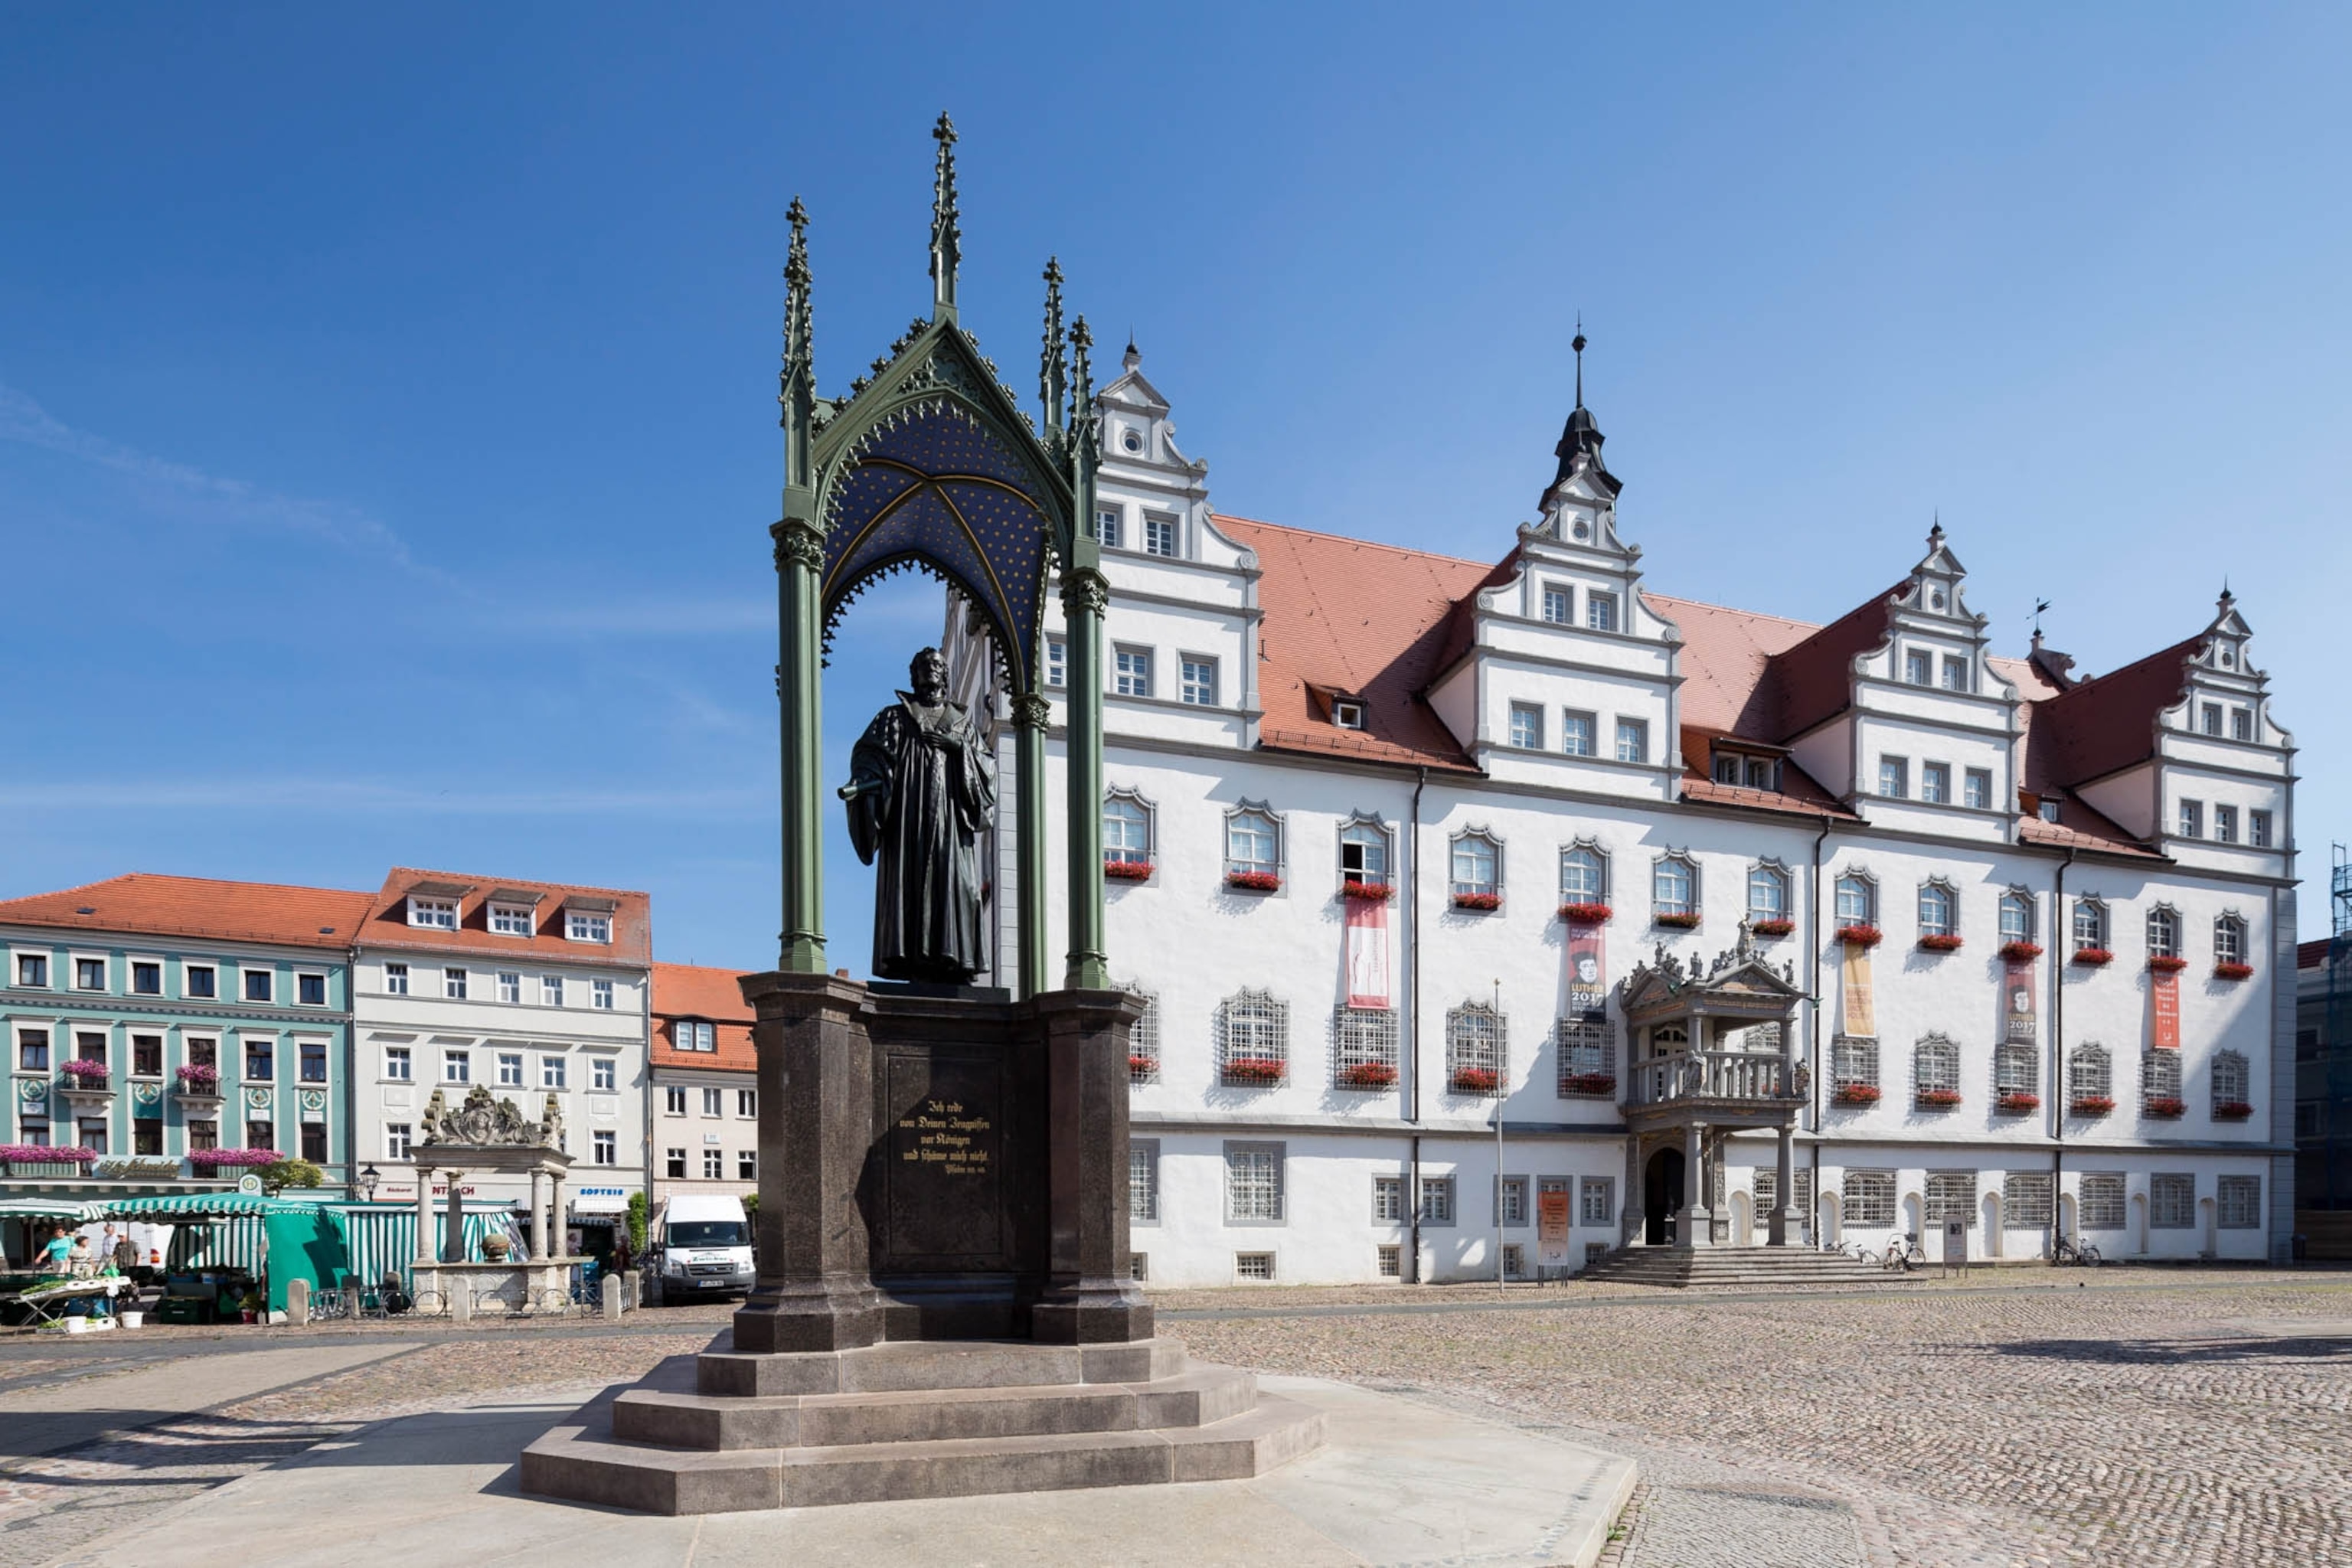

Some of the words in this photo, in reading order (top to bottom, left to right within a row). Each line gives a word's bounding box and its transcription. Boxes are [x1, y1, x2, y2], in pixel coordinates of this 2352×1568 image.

[1572, 983, 1604, 993] LUTHER
[1572, 991, 1604, 1007] 2017
[2009, 1012, 2034, 1021] LUTHER
[2009, 1021, 2035, 1034] 2017
[928, 1099, 945, 1114] Ich
[946, 1102, 963, 1113] rede
[919, 1116, 946, 1129] Deinen
[920, 1136, 935, 1145] vor
[903, 1148, 919, 1160] und
